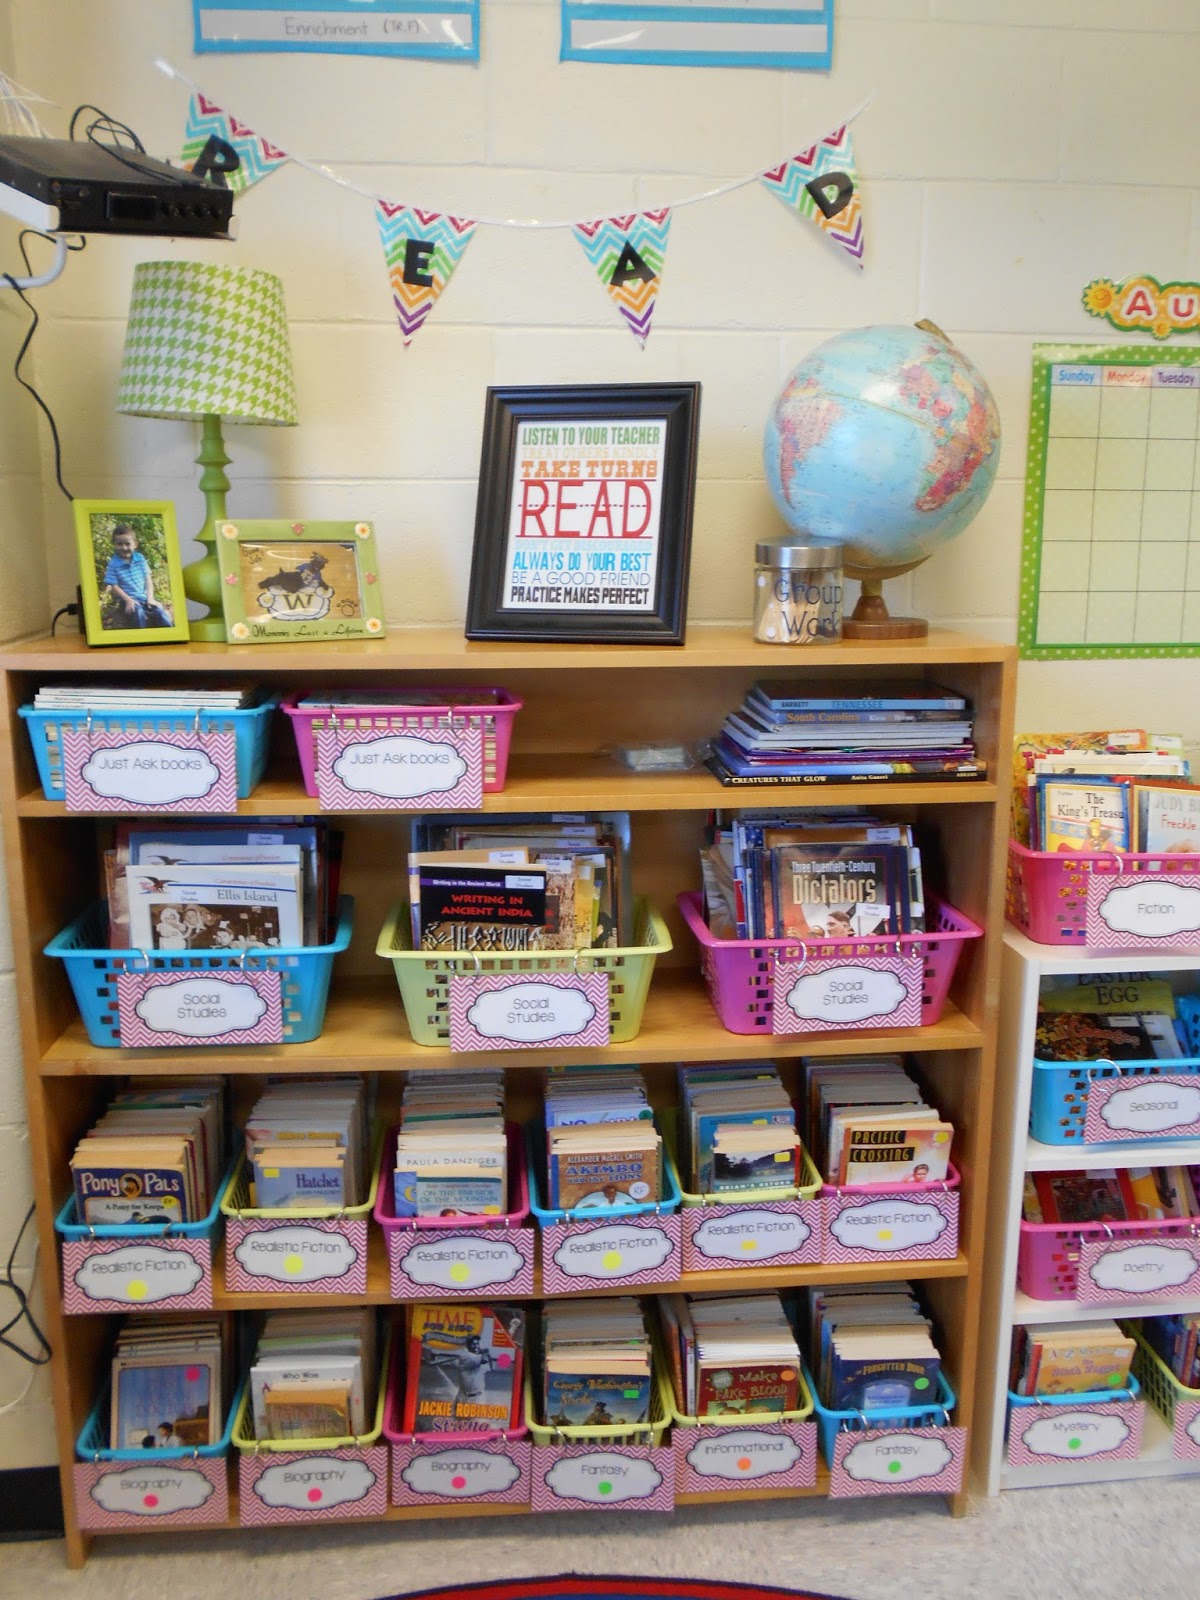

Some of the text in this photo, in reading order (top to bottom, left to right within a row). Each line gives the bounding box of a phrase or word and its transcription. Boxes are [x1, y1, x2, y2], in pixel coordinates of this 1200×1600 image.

[284, 16, 368, 36] Enrichment
[192, 135, 854, 287] R E A D
[1059, 370, 1194, 386] Sunday Monday Tuesday
[522, 426, 660, 445] LISTEN TO YOUR TEACHER
[521, 459, 658, 479] TAKE TURNS
[519, 480, 652, 537] READ
[513, 552, 652, 571] ALWAYS DO YOUR BEST
[511, 571, 651, 586] BE A GOOD FRIEND
[510, 586, 649, 604] PRACTICE MAKES PERFECT
[773, 579, 842, 606] Group
[282, 594, 314, 610] W
[781, 610, 839, 638] Work
[832, 700, 884, 709] TENNESSEE
[786, 712, 816, 722] South
[818, 712, 860, 722] Carolina
[99, 758, 202, 770] Just Ask books
[350, 752, 450, 765] Just Ask books
[732, 776, 778, 784] CREATURES
[1085, 792, 1104, 804] The
[1154, 796, 1186, 811] JUDY
[1057, 804, 1089, 819] King's
[1161, 814, 1196, 831] Freckle
[791, 861, 811, 873] Three
[217, 889, 278, 902] Ellis Island
[793, 874, 877, 905] Dictators
[451, 894, 523, 904] WRITING IN
[441, 907, 533, 917] ANCIENT INDIA
[1138, 903, 1175, 914] Fiction
[829, 980, 863, 993] Social
[183, 993, 220, 1005] Social
[823, 993, 868, 1006] Studies
[1094, 986, 1139, 1006] EGG
[513, 997, 549, 1010] Social
[177, 1007, 227, 1019] Studies
[507, 1011, 556, 1024] Studies
[1130, 1100, 1178, 1112] Seasonal
[854, 1131, 900, 1144] PACIFIC
[852, 1148, 909, 1161] CROSSING
[406, 1157, 498, 1166] PAULA DANZIGER
[566, 1163, 643, 1175] AKIMBO
[296, 1173, 340, 1188] Hatchet
[609, 1173, 642, 1181] LIONS
[80, 1172, 179, 1197] Pony Pals
[846, 1213, 931, 1225] Realistic Fiction
[708, 1222, 795, 1235] Realistic Fiction
[252, 1241, 341, 1253] Realistic Fiction
[570, 1237, 658, 1254] Realistic Fiction
[417, 1249, 508, 1262] Realistic Fiction
[92, 1260, 187, 1274] Realistic Fiction
[1124, 1262, 1164, 1273] Poetry
[423, 1308, 476, 1326] TIME
[740, 1370, 778, 1383] Make
[715, 1384, 787, 1400] FAKE BLOOD
[418, 1401, 507, 1419] JACKIE ROBINSON
[1053, 1422, 1099, 1433] Mystery
[705, 1443, 784, 1454] Informational
[875, 1445, 920, 1456] Fantasy
[431, 1461, 491, 1472] Biography
[581, 1465, 629, 1477] Fantasy
[284, 1470, 346, 1484] Biography
[120, 1478, 183, 1491] Biography
